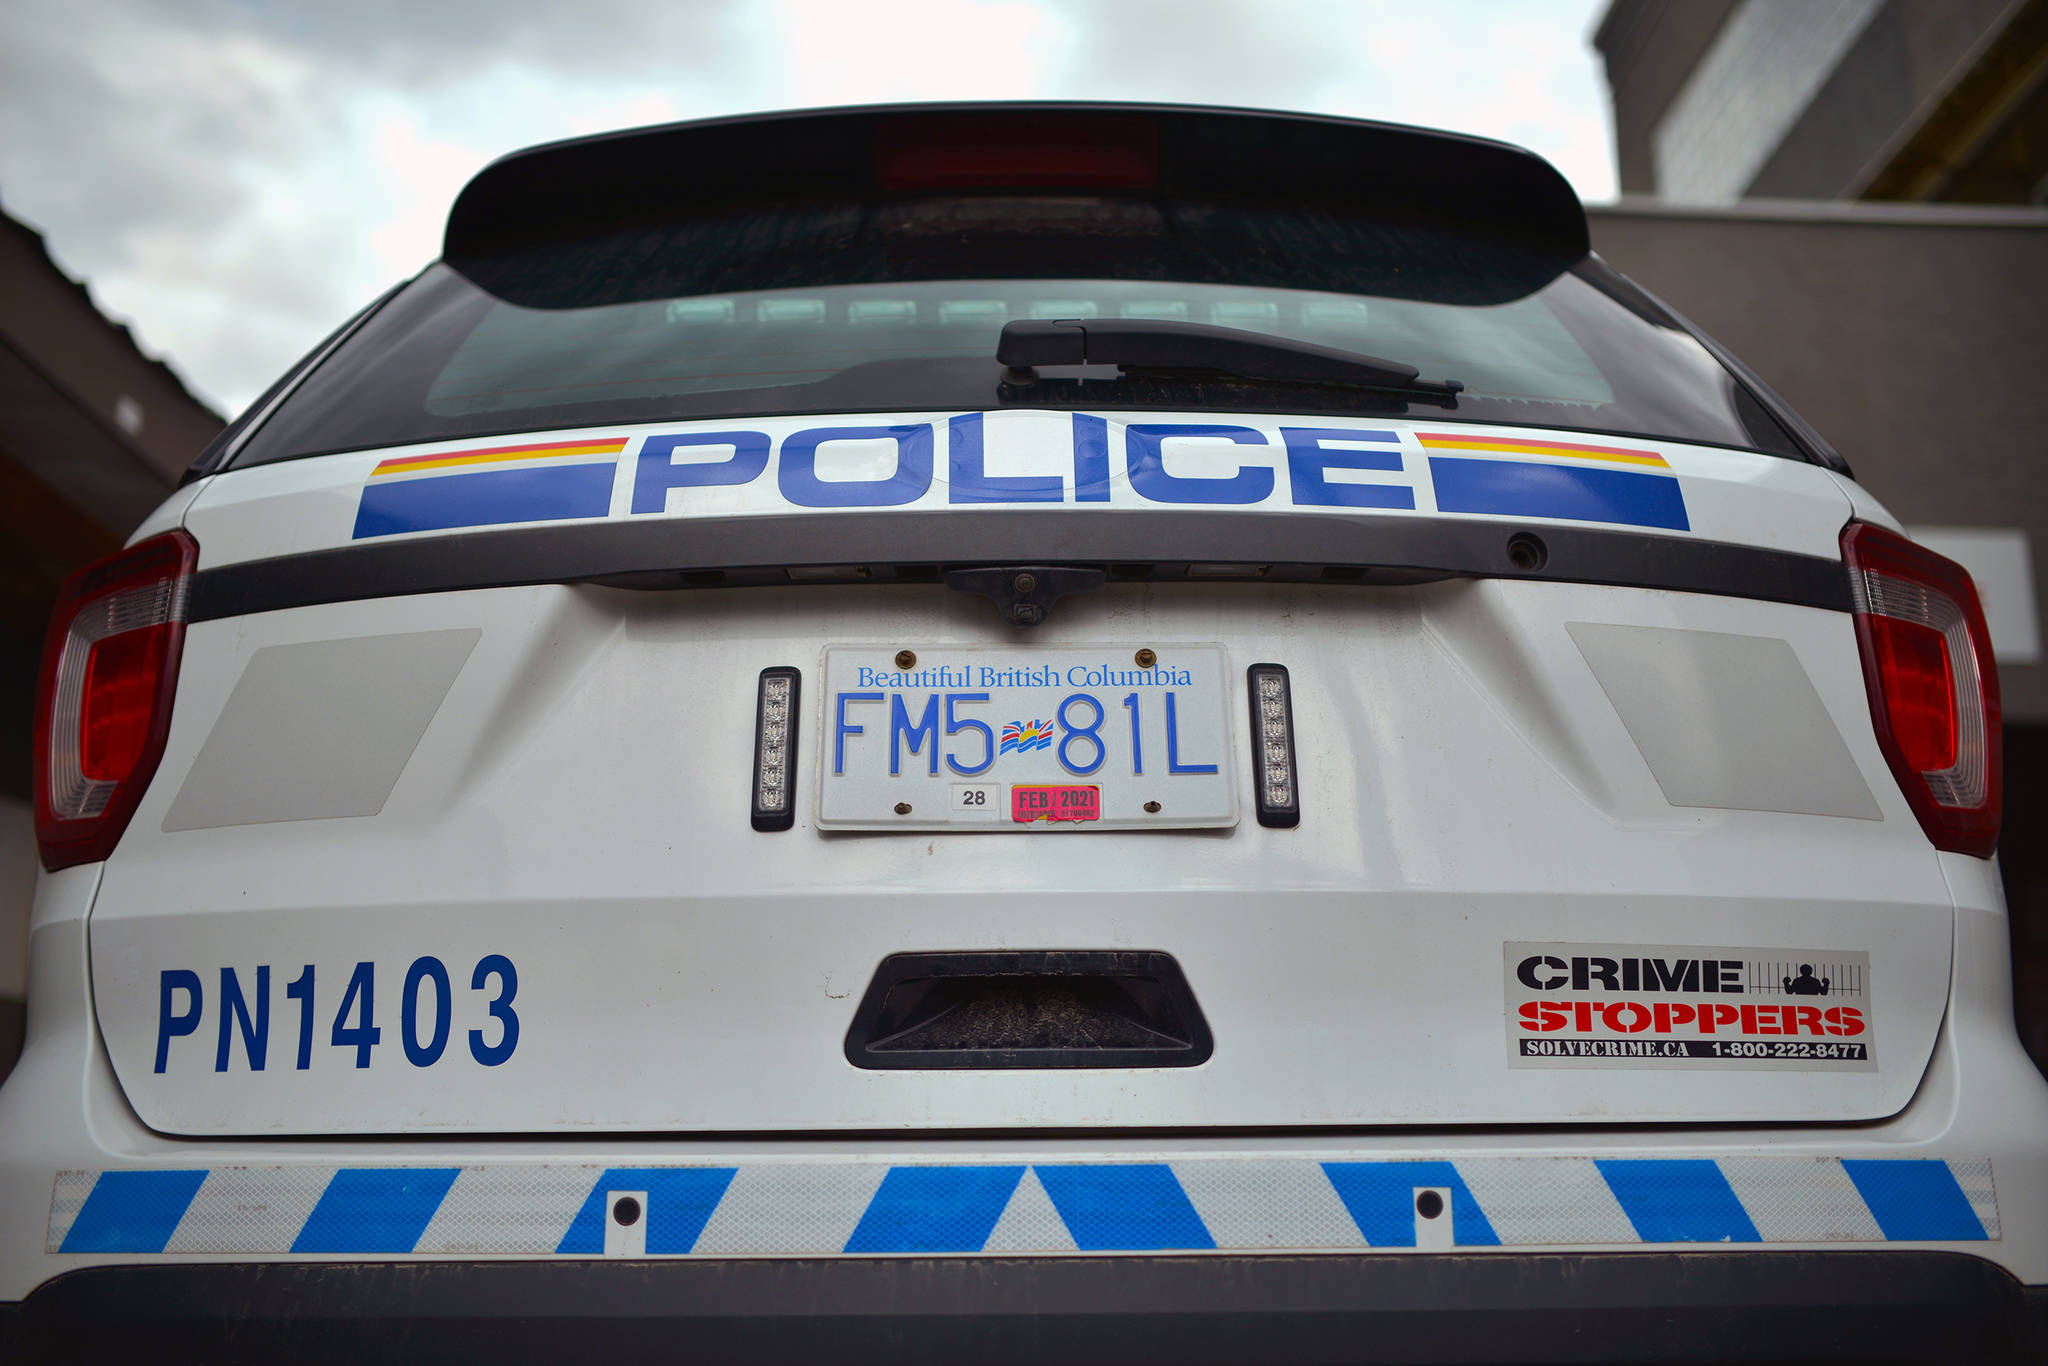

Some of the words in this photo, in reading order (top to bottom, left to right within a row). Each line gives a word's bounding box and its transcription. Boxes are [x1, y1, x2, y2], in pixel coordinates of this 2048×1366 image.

[631, 411, 1416, 515] POLICE
[857, 664, 972, 688] Beautiful
[979, 665, 1061, 688] British
[1067, 664, 1192, 688] Columbia
[834, 691, 995, 776] FM5
[1056, 691, 1219, 776] 81L
[962, 790, 986, 805] 28
[1019, 791, 1048, 808] FEB
[1061, 790, 1095, 807] 2021
[1516, 955, 1744, 993] CRIME
[154, 954, 520, 1074] PN1403
[1518, 1001, 1865, 1037] STOPPERS
[1526, 1039, 1690, 1057] SOLVECRIME.CA
[1712, 1042, 1862, 1058] 1-800-222-8477
